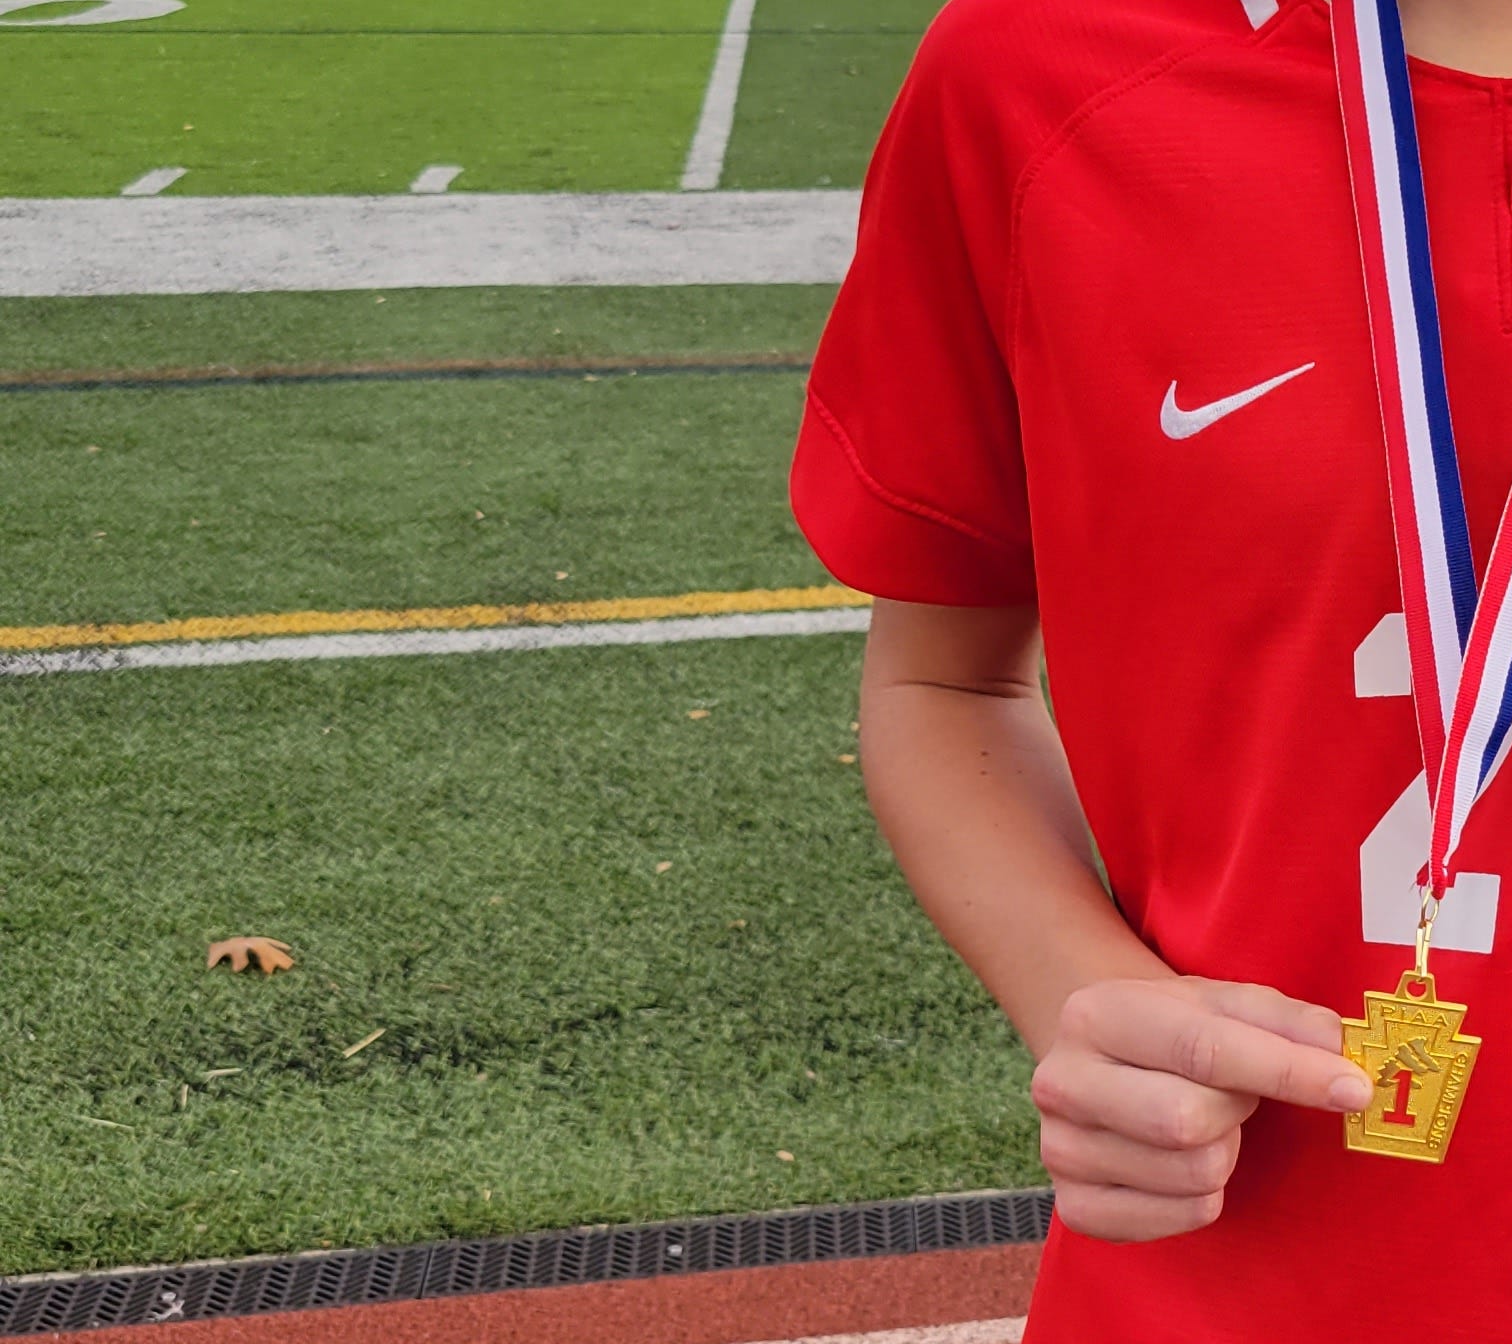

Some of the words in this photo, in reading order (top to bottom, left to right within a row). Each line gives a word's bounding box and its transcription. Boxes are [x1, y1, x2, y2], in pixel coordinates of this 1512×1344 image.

[1381, 1003, 1449, 1027] PIAA
[1384, 1070, 1415, 1127] 1
[1427, 1051, 1468, 1150] CHAMPIONS
